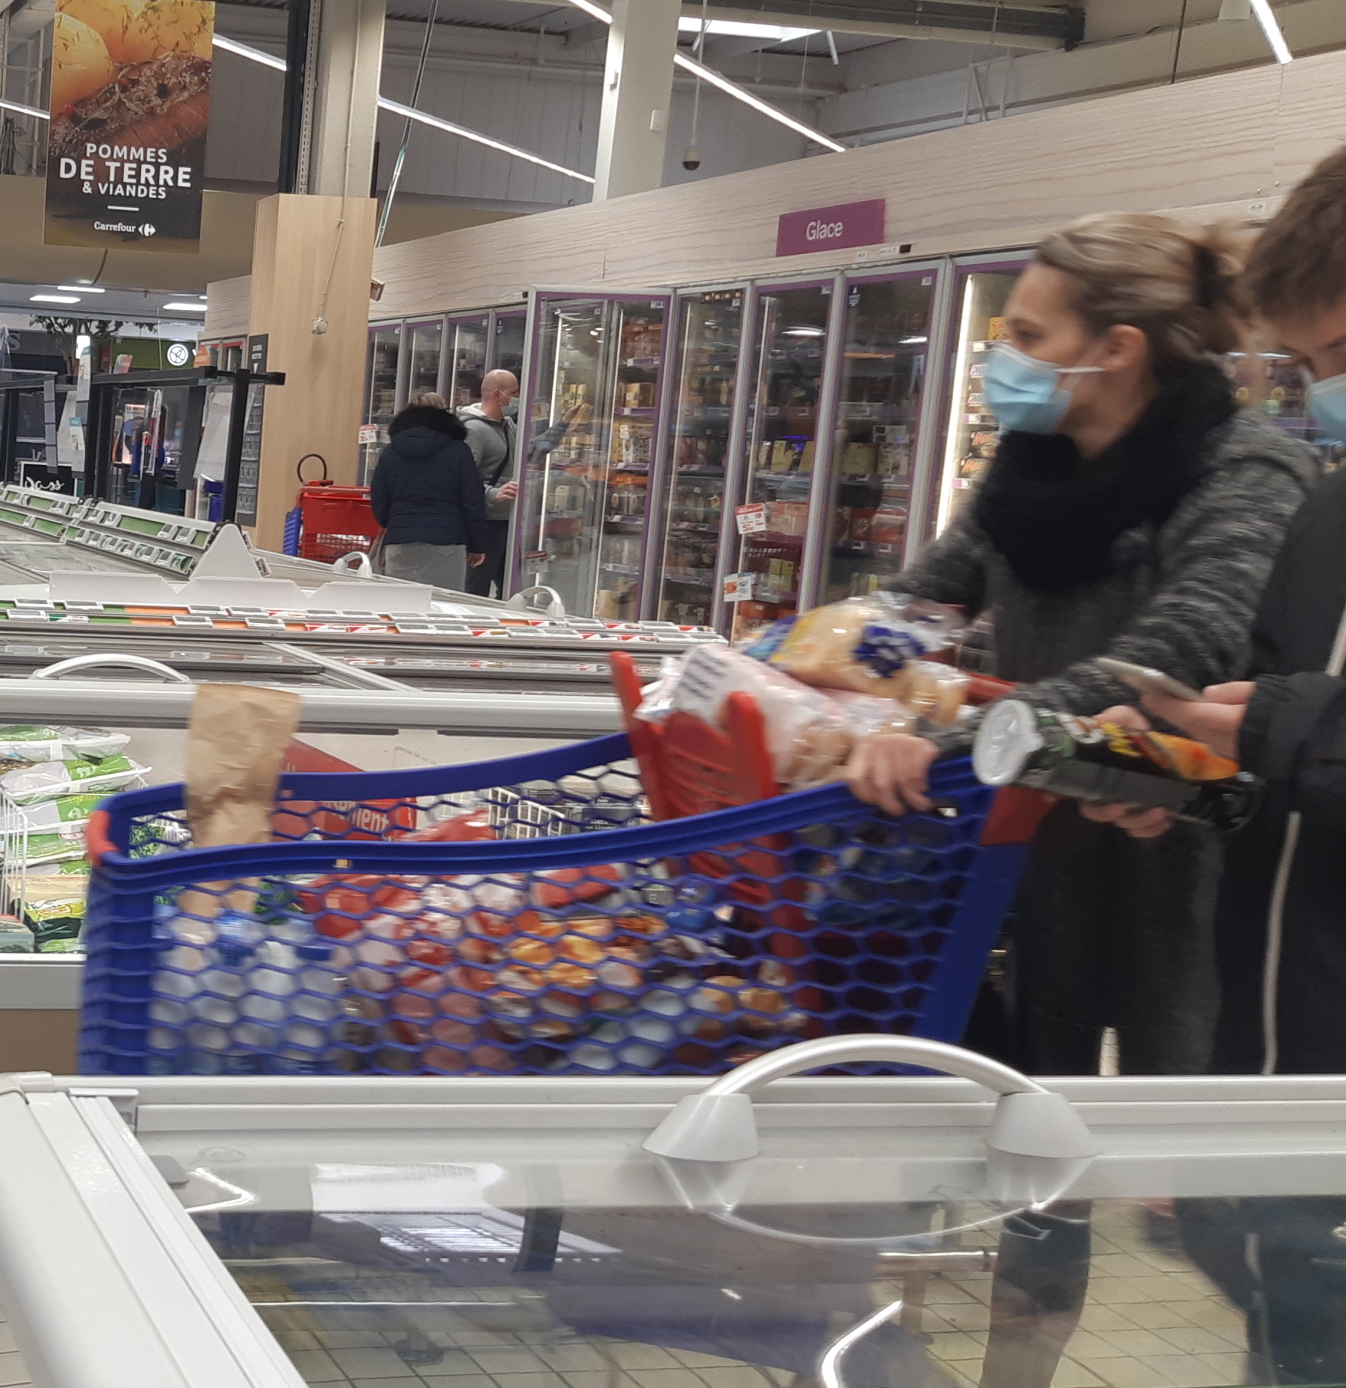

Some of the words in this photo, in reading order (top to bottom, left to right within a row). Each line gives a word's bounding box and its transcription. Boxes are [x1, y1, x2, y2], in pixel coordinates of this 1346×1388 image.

[85, 143, 168, 163] POMMES
[59, 157, 95, 180] DE
[105, 161, 192, 188] TERRE
[82, 181, 93, 194] &
[97, 182, 167, 199] VIANDES
[93, 221, 137, 233] Carrefour
[805, 219, 844, 241] Glace
